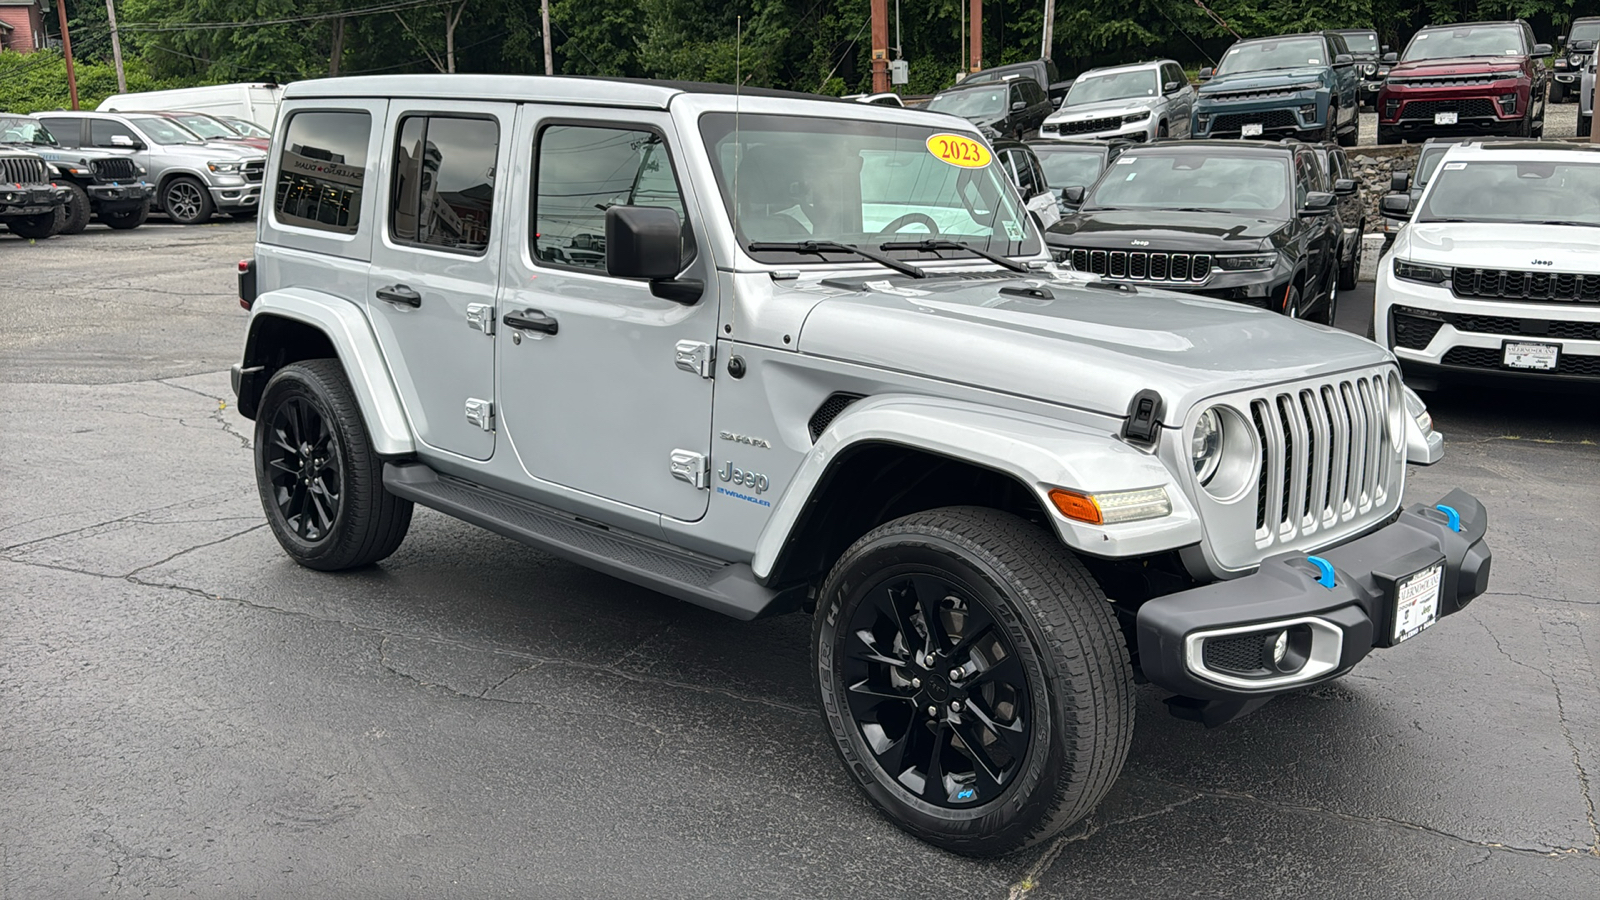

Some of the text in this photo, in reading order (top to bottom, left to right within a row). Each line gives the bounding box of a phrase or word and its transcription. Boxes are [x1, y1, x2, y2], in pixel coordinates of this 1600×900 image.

[939, 139, 980, 162] 2023
[719, 430, 771, 450] SAHARA
[717, 460, 769, 495] Jeep
[725, 488, 771, 507] WRANGLER
